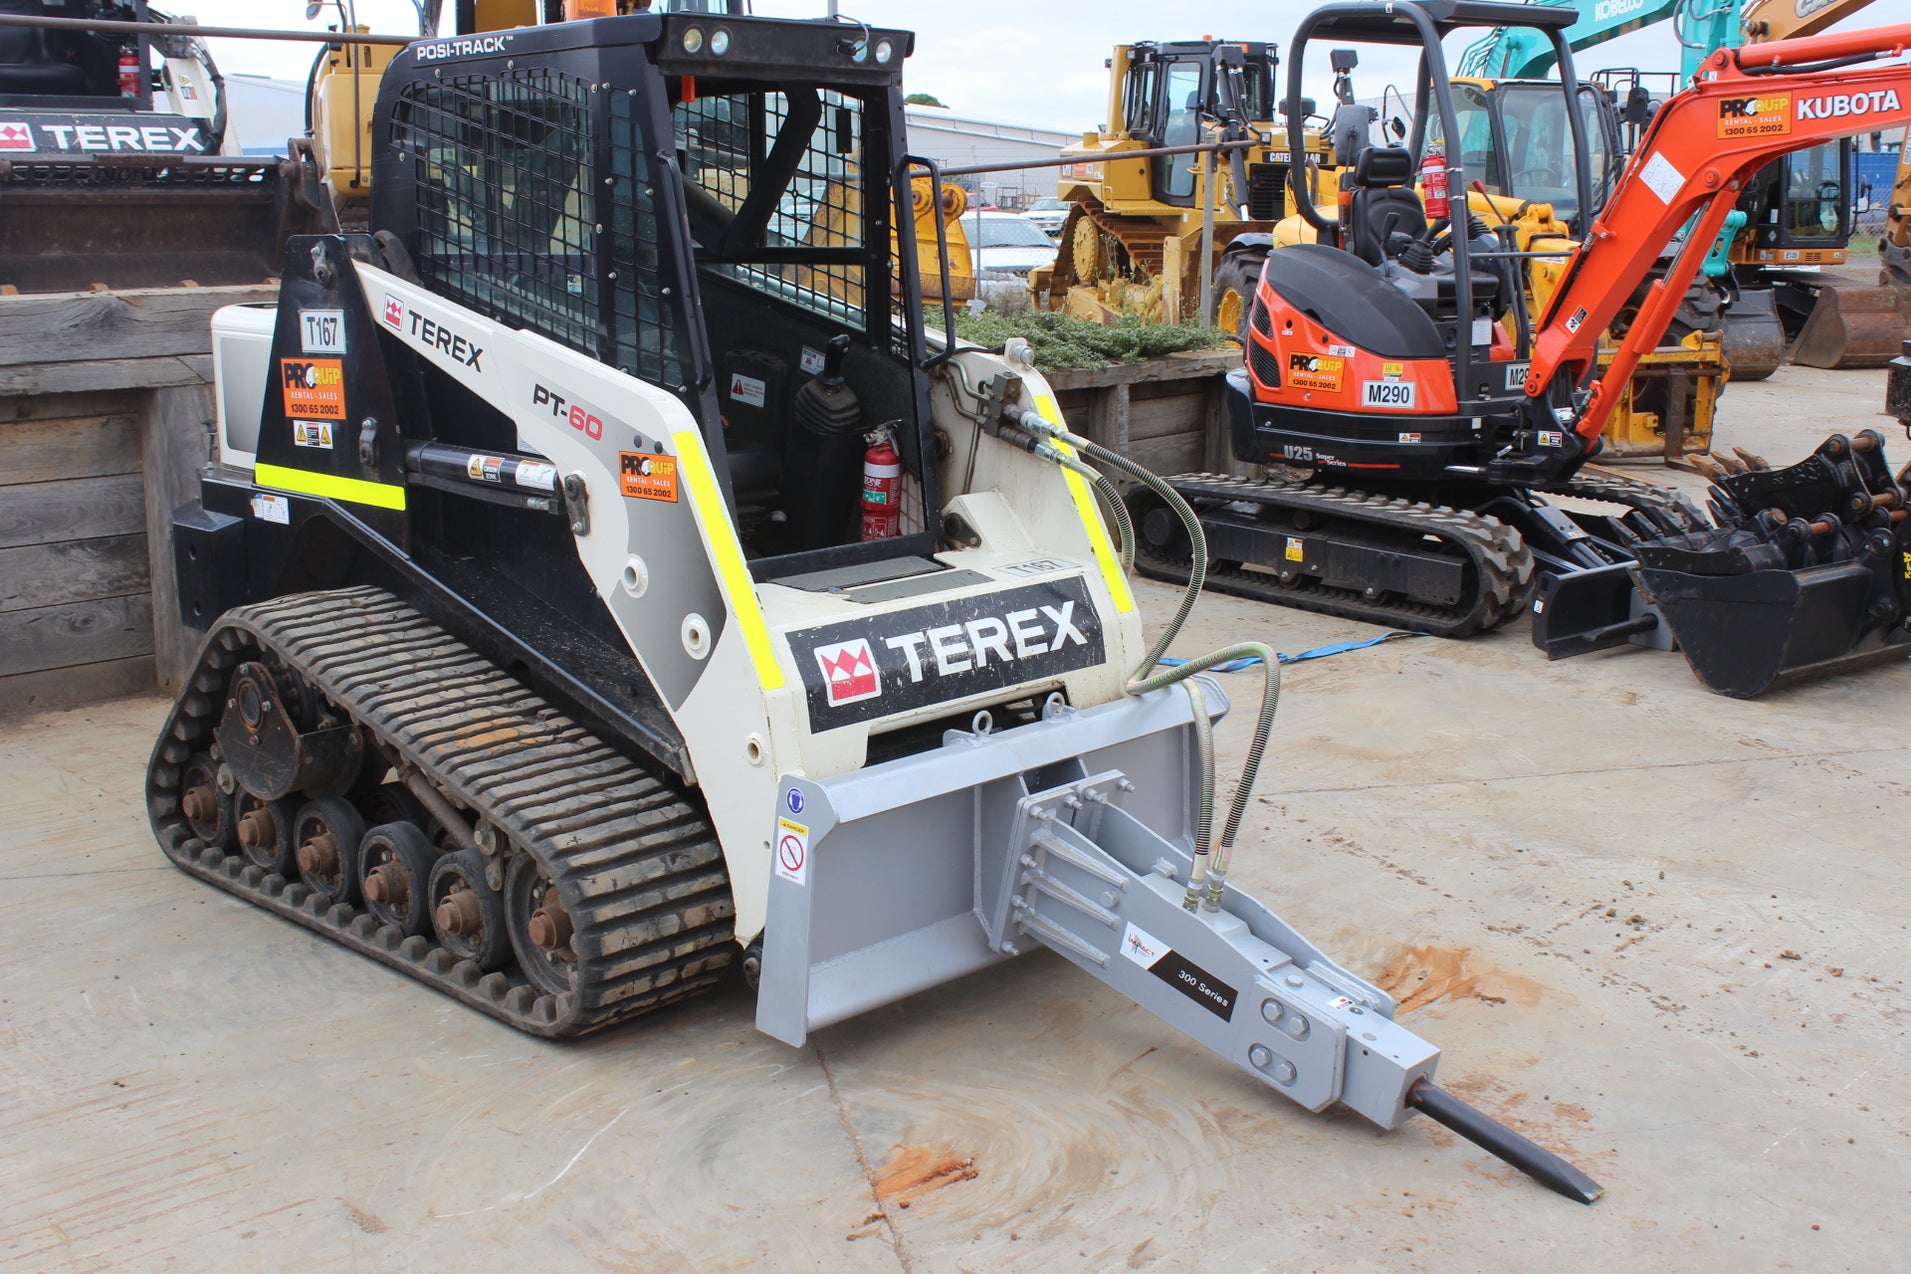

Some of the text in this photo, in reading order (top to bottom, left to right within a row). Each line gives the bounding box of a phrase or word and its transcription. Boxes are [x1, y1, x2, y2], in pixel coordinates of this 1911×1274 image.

[1797, 89, 1902, 120] KUBOTA
[1724, 117, 1752, 126] RENTAL
[1759, 115, 1782, 123] SALES
[1724, 124, 1783, 135] 1300 65 2002
[42, 125, 206, 151] TEREX
[307, 316, 338, 346] T167
[408, 309, 484, 373] TEREX
[1293, 379, 1336, 389] 1300 65 2002
[291, 391, 314, 399] RENTAL
[318, 391, 338, 400] SALES
[1368, 384, 1410, 404] M290
[291, 403, 340, 415] 1300 65 2002
[532, 383, 604, 441] PT-60
[1283, 444, 1313, 461] U25
[1315, 452, 1335, 461] Super
[1325, 459, 1347, 467] Series
[626, 475, 648, 485] RENTAL
[652, 478, 671, 487] SALES
[626, 485, 672, 498] 1300 65 2002
[1006, 559, 1063, 574] T167
[885, 600, 1089, 684] TEREX
[1178, 970, 1229, 1007] 300 Series
